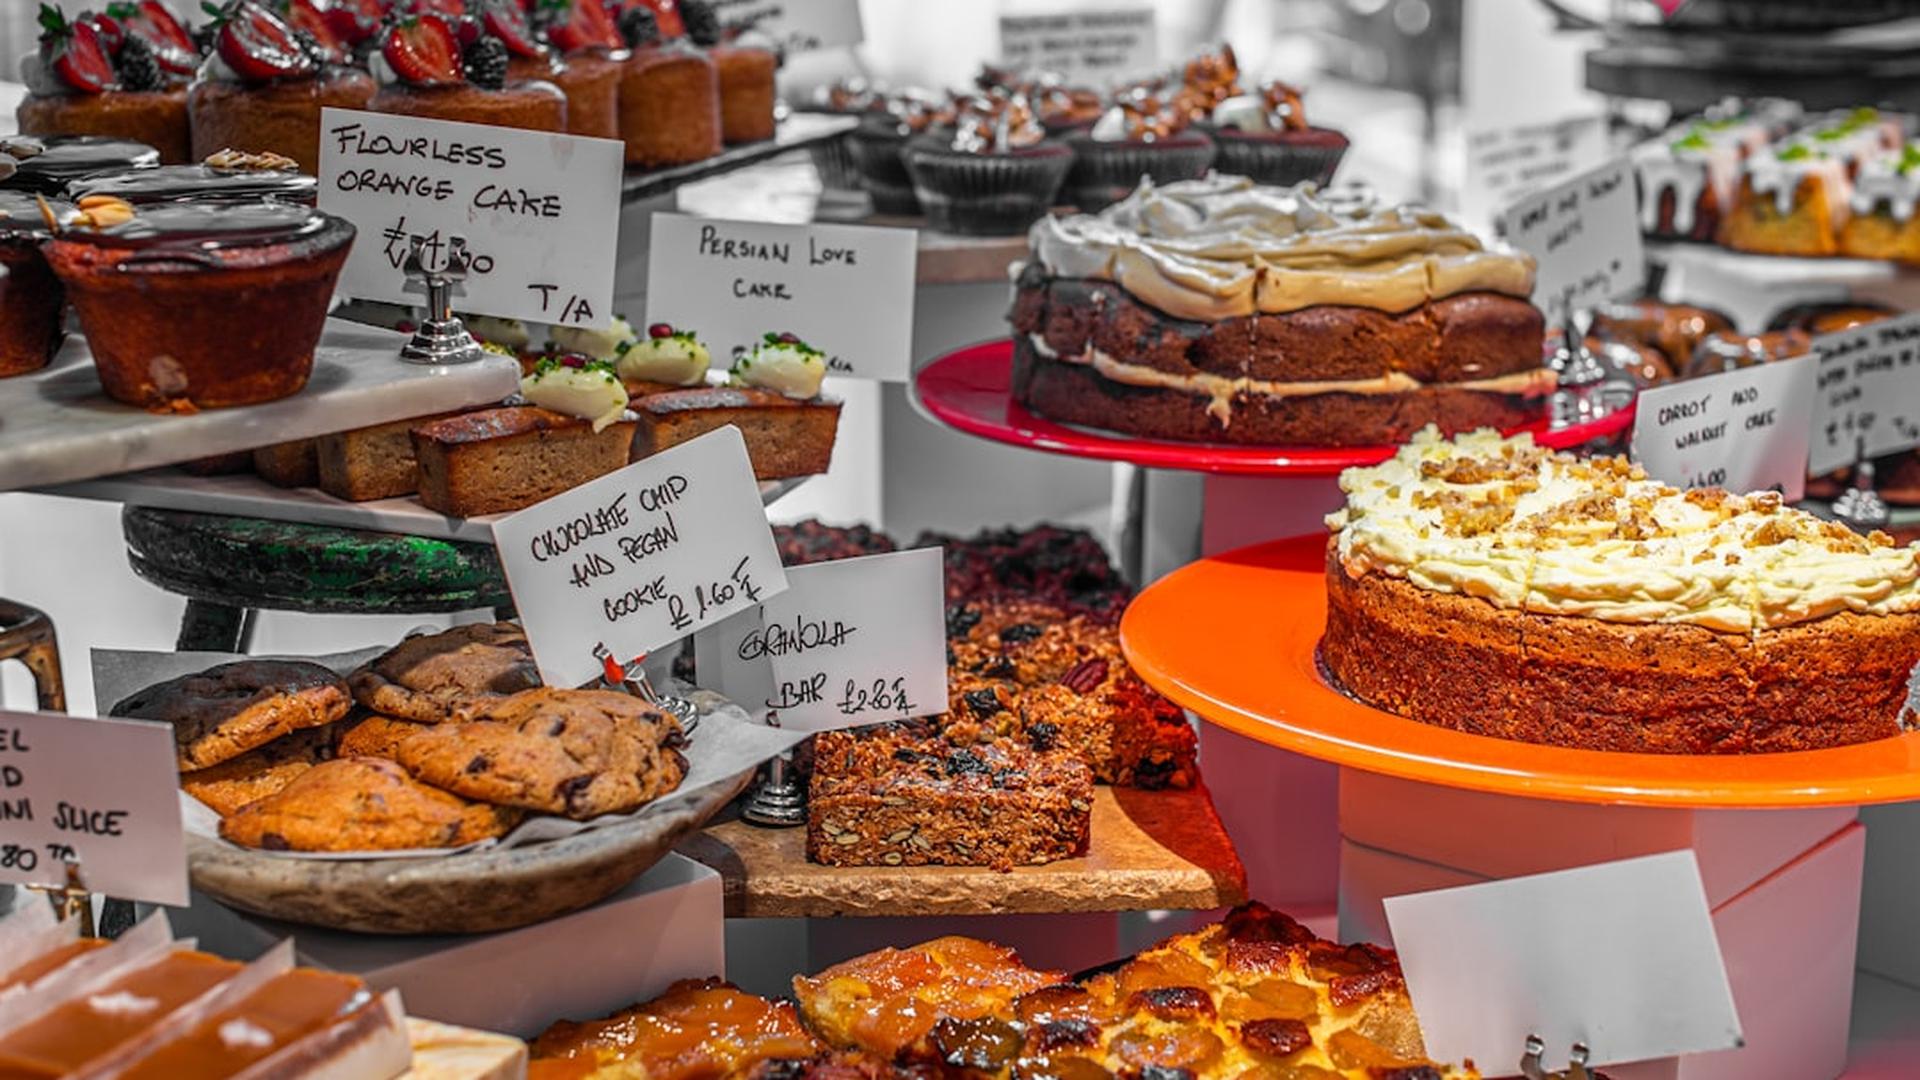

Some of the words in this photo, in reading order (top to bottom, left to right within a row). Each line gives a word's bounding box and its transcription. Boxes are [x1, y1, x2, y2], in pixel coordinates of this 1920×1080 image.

[331, 124, 506, 168] FLOURLESS
[337, 169, 454, 200] ORANGE
[474, 185, 561, 217] CAKE
[700, 225, 789, 263] PERSIAN
[809, 237, 857, 266] LOVE
[733, 278, 792, 300] CAKE
[1658, 394, 1712, 426] CARROT
[1732, 386, 1758, 406] AND
[1675, 421, 1728, 450] WALNUT
[531, 492, 629, 561] CHOCOLATE
[639, 476, 688, 512] CHIP
[570, 553, 615, 588] AND
[618, 512, 679, 563] PECAN
[604, 576, 668, 622] COOKIE
[738, 613, 857, 660] GRANOLA
[765, 672, 827, 709] BAR
[0, 798, 33, 820] NI
[53, 802, 129, 836] SLICE
